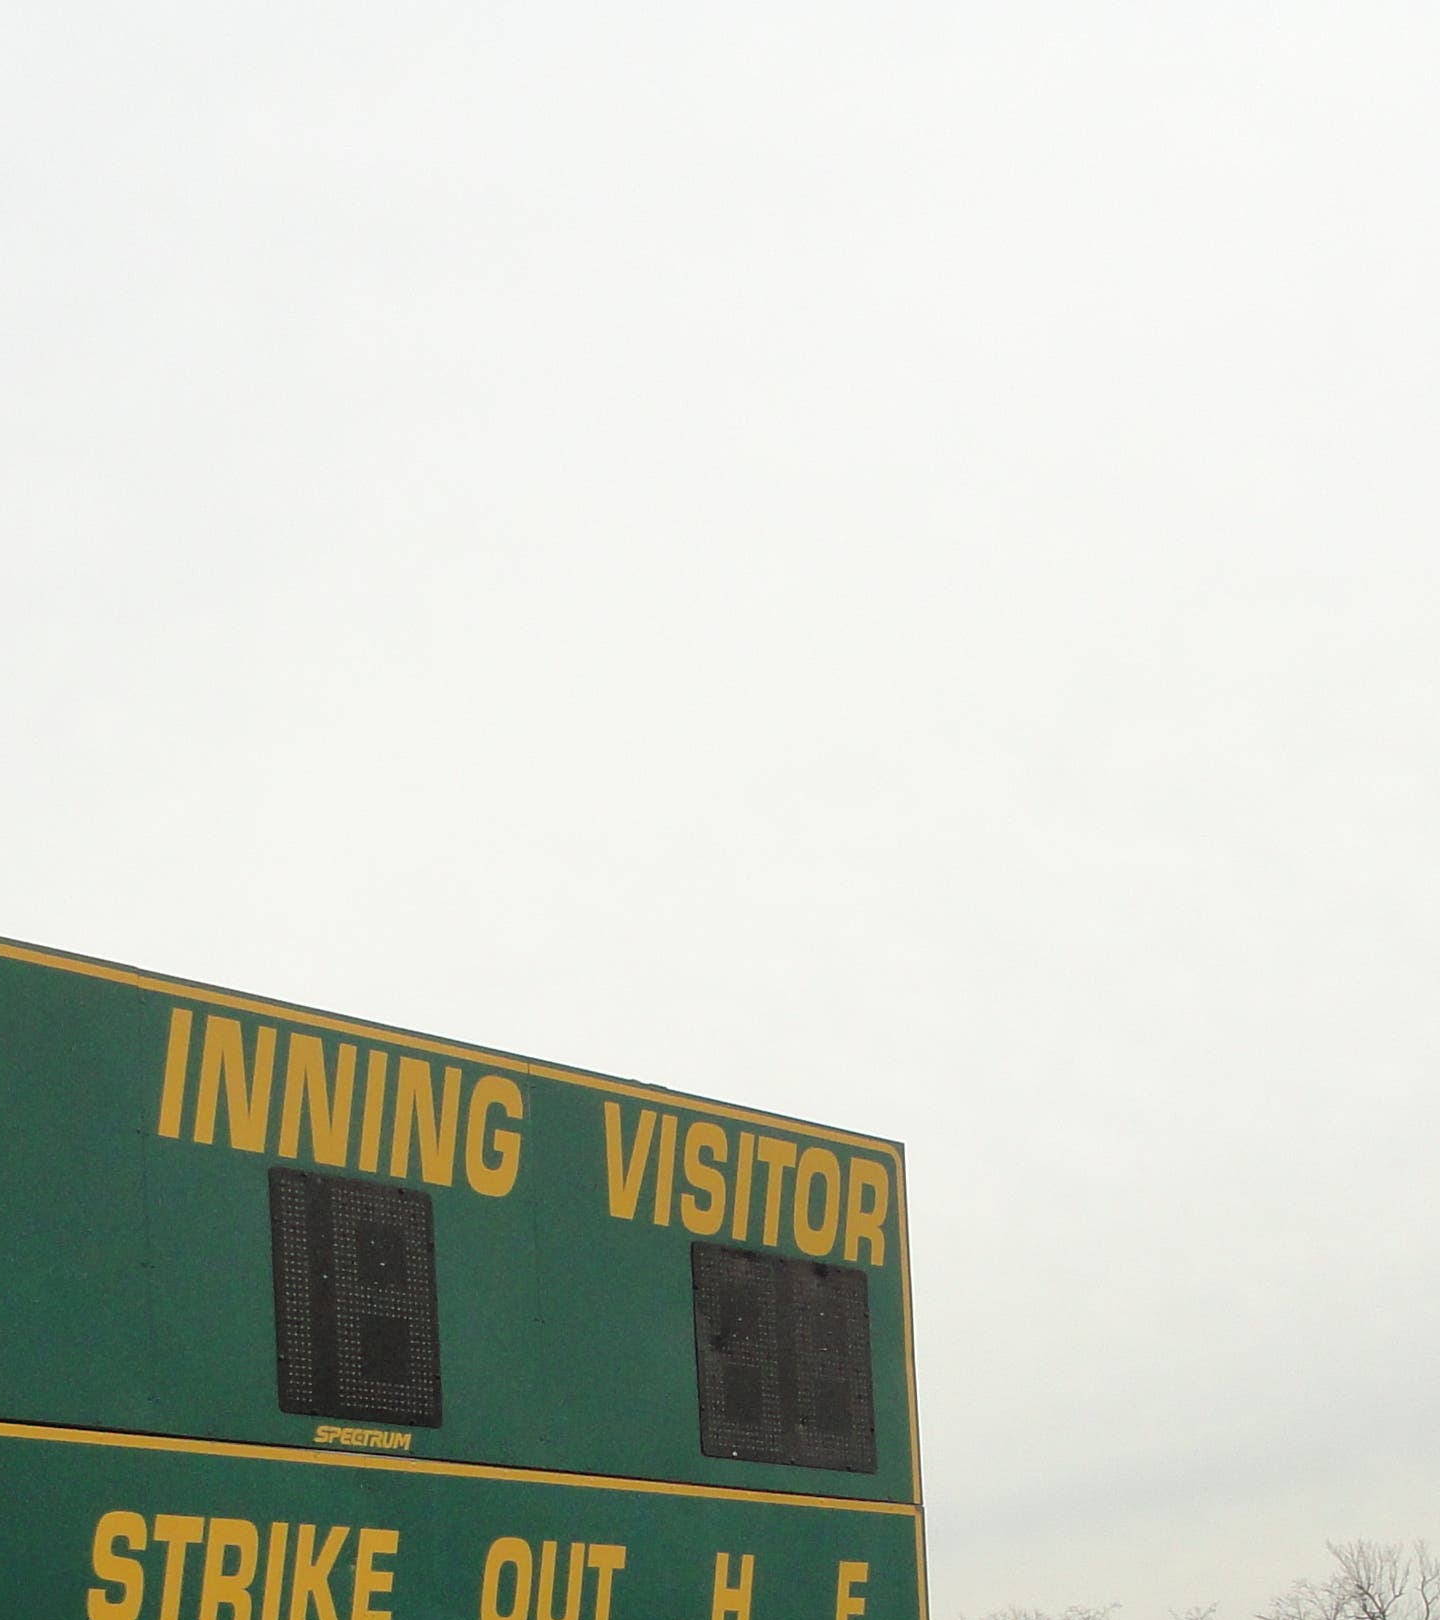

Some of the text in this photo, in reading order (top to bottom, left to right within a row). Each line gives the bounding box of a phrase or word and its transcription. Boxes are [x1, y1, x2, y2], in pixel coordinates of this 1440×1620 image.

[157, 1007, 524, 1197] INNING
[603, 1101, 890, 1266] VISITOR
[313, 1425, 412, 1451] SPECTRUM
